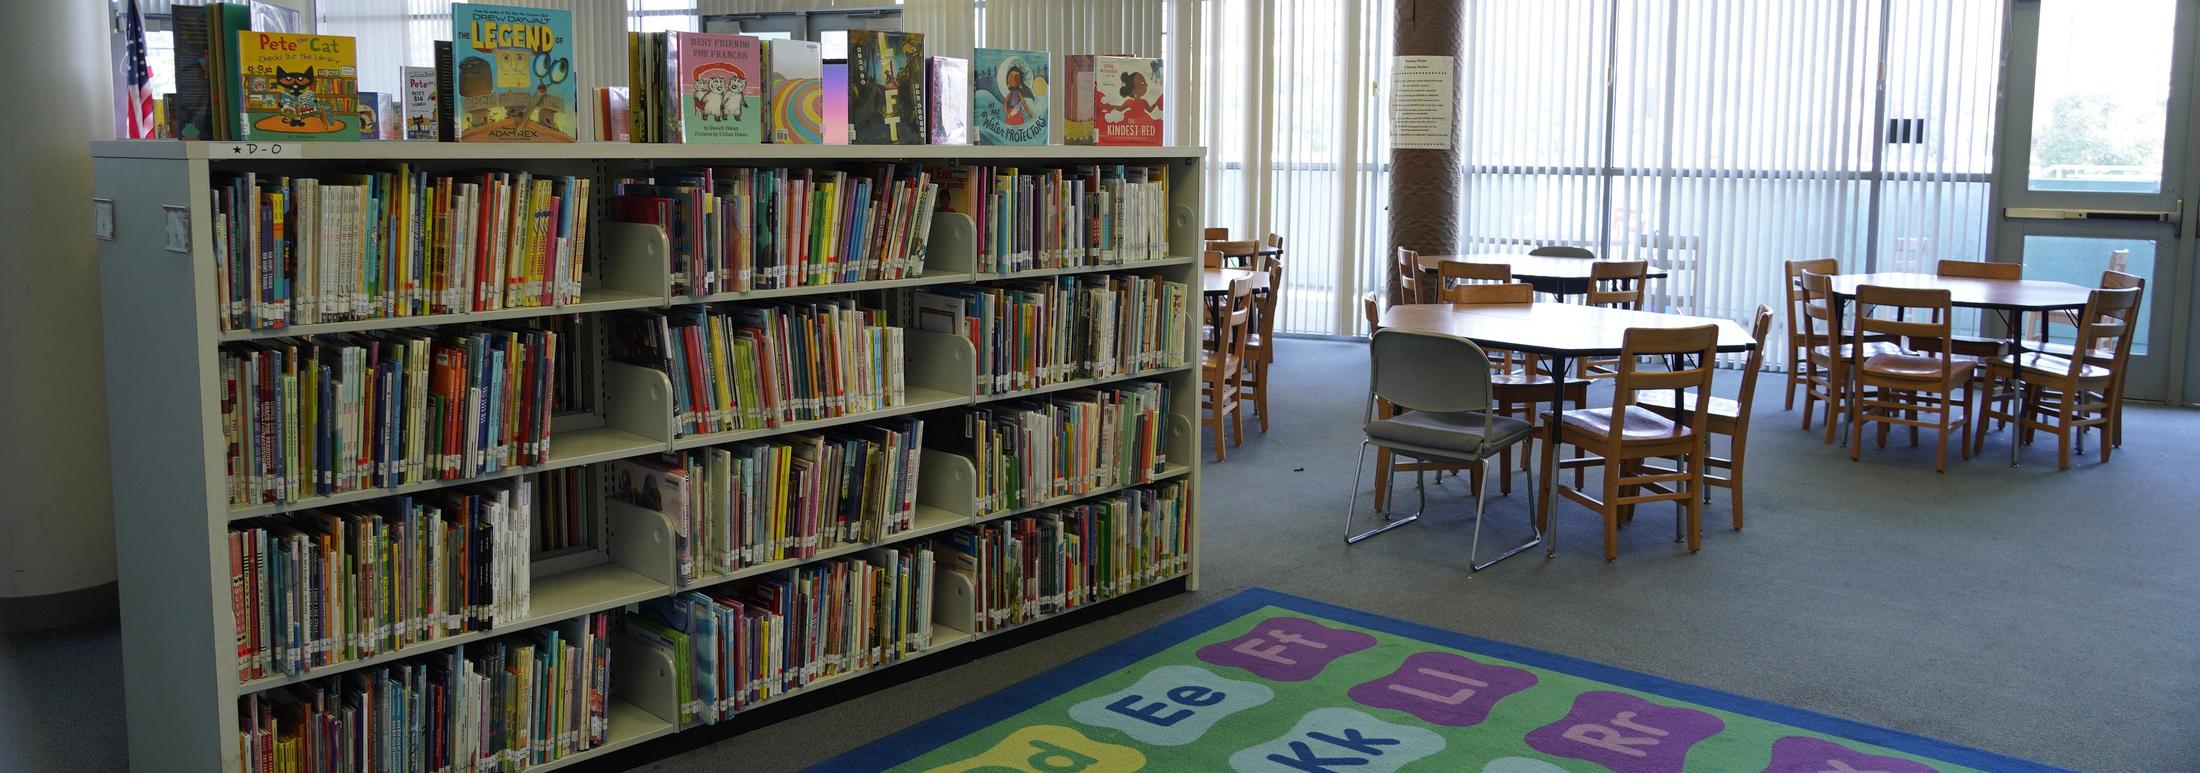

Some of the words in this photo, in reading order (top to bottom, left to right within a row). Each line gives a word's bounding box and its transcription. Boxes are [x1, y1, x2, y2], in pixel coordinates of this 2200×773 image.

[473, 14, 506, 23] DREW
[507, 15, 551, 24] DAYWALT
[259, 34, 297, 52] Pete
[310, 38, 340, 54] Cat
[458, 32, 470, 40] THE
[470, 20, 555, 55] LEGEND
[690, 37, 712, 47] BEST
[714, 38, 751, 49] FRIENDS
[314, 54, 342, 64] Library
[692, 48, 709, 58] FOR
[710, 50, 748, 60] FRANCES
[410, 79, 428, 88] Pete
[488, 130, 516, 138] ADAM
[982, 112, 1005, 138] Water
[1005, 114, 1048, 142] PROTECTORS
[1107, 124, 1139, 136] KINDEST
[1141, 125, 1156, 136] RED
[1233, 629, 1329, 666] Ff
[1105, 685, 1227, 729] Ee
[1561, 710, 1673, 759] Rr
[1265, 728, 1401, 773] Kk
